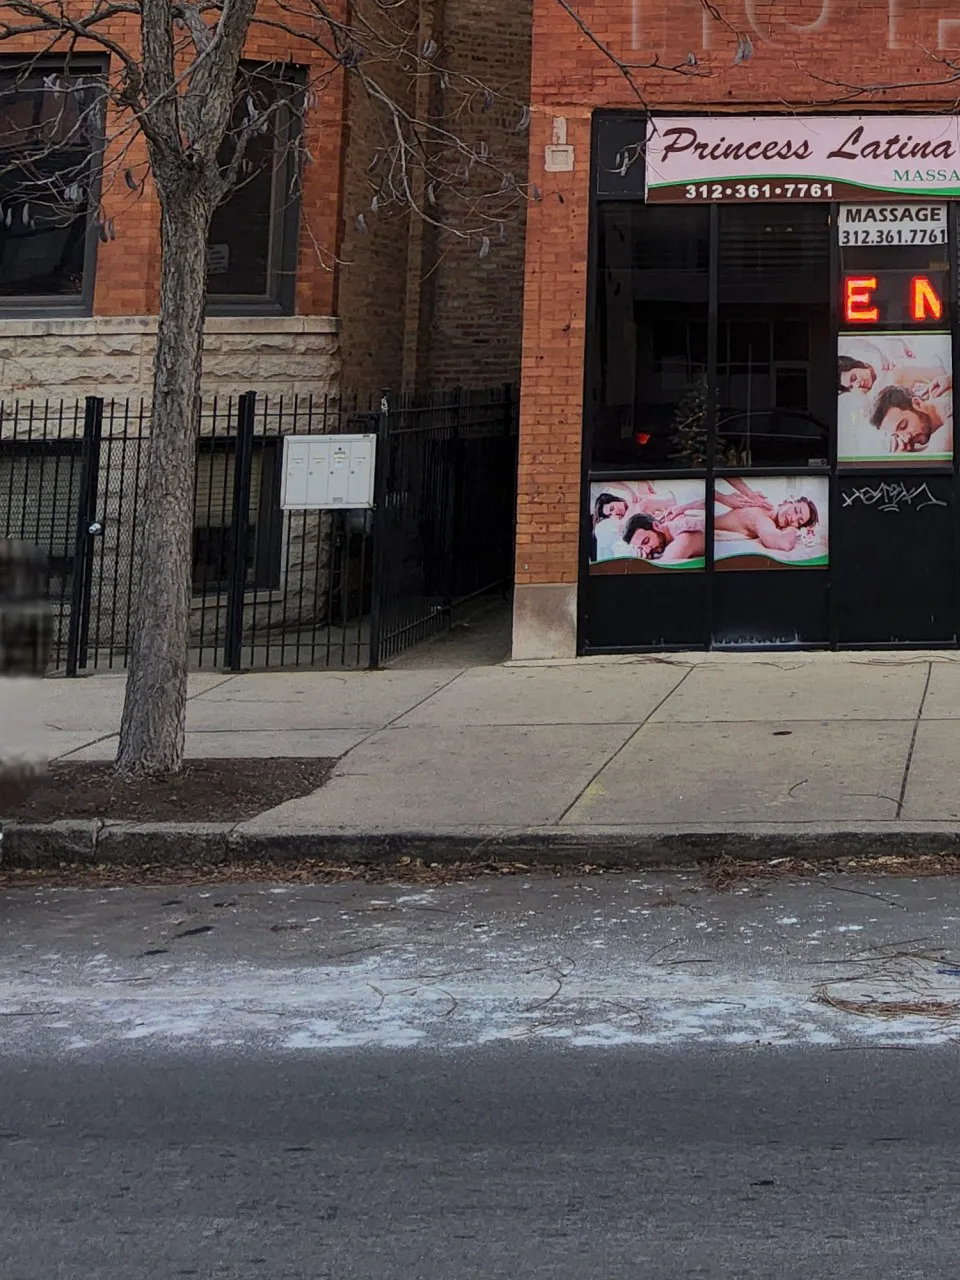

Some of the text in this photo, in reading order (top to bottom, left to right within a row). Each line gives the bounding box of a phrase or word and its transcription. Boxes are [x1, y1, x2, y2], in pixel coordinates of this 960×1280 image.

[661, 127, 814, 162] Princess
[827, 126, 956, 160] Latina
[845, 207, 942, 224] MASSAGE
[842, 229, 946, 245] 312.361.7761
